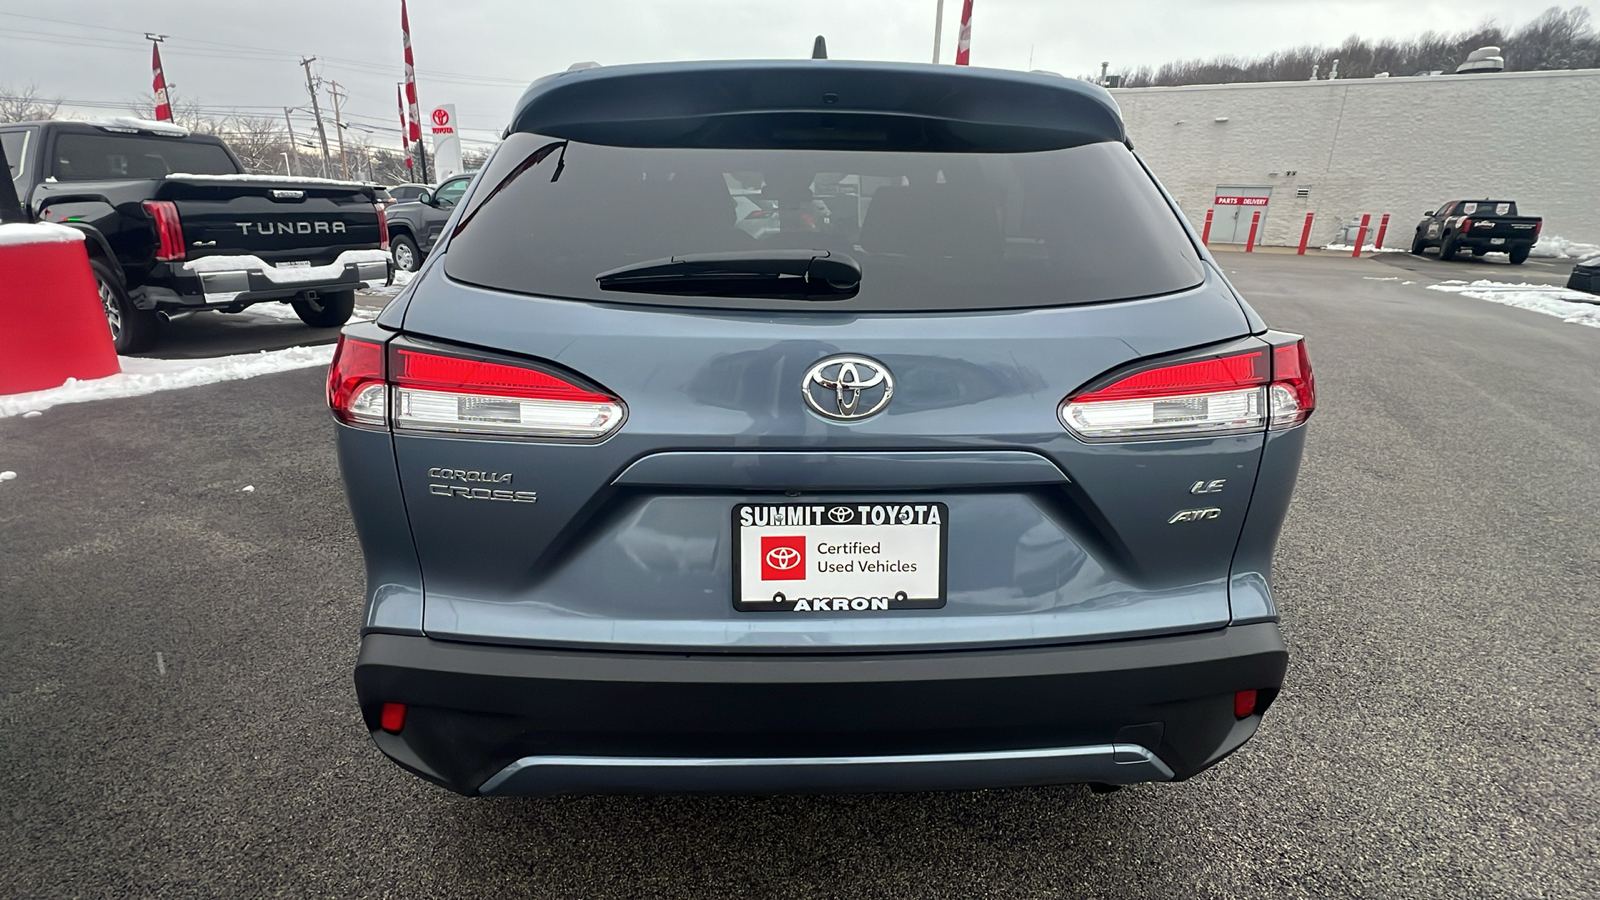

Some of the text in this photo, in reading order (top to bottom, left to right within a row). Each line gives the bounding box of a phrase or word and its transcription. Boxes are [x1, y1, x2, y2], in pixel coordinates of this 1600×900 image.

[235, 221, 347, 235] TUNDRA
[428, 467, 513, 484] COROLLA
[429, 483, 537, 503] CROSS
[1189, 478, 1226, 494] LE
[740, 505, 941, 526] SUMMIT TOYOTA
[817, 542, 881, 554] Certified
[817, 560, 917, 573] Used Vehicles
[793, 597, 889, 611] AKRON
